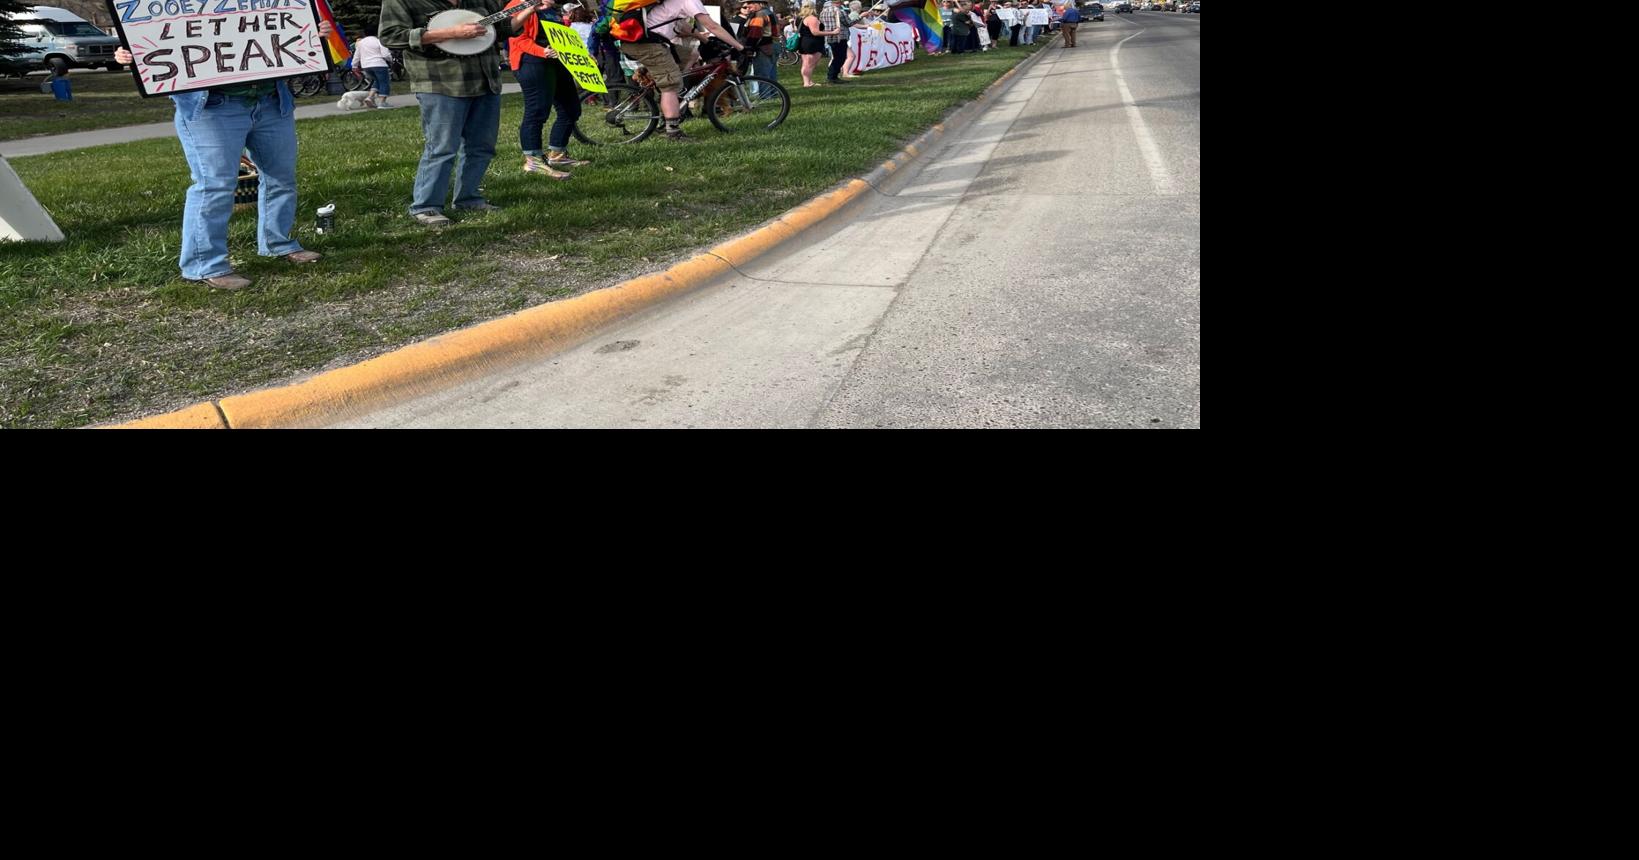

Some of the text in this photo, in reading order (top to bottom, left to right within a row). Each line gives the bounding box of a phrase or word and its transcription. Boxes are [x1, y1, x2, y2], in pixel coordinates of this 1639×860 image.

[115, 0, 209, 23] ZOOEY
[160, 12, 303, 40] LET HER
[549, 27, 567, 47] MY
[142, 31, 316, 82] SPEAK!
